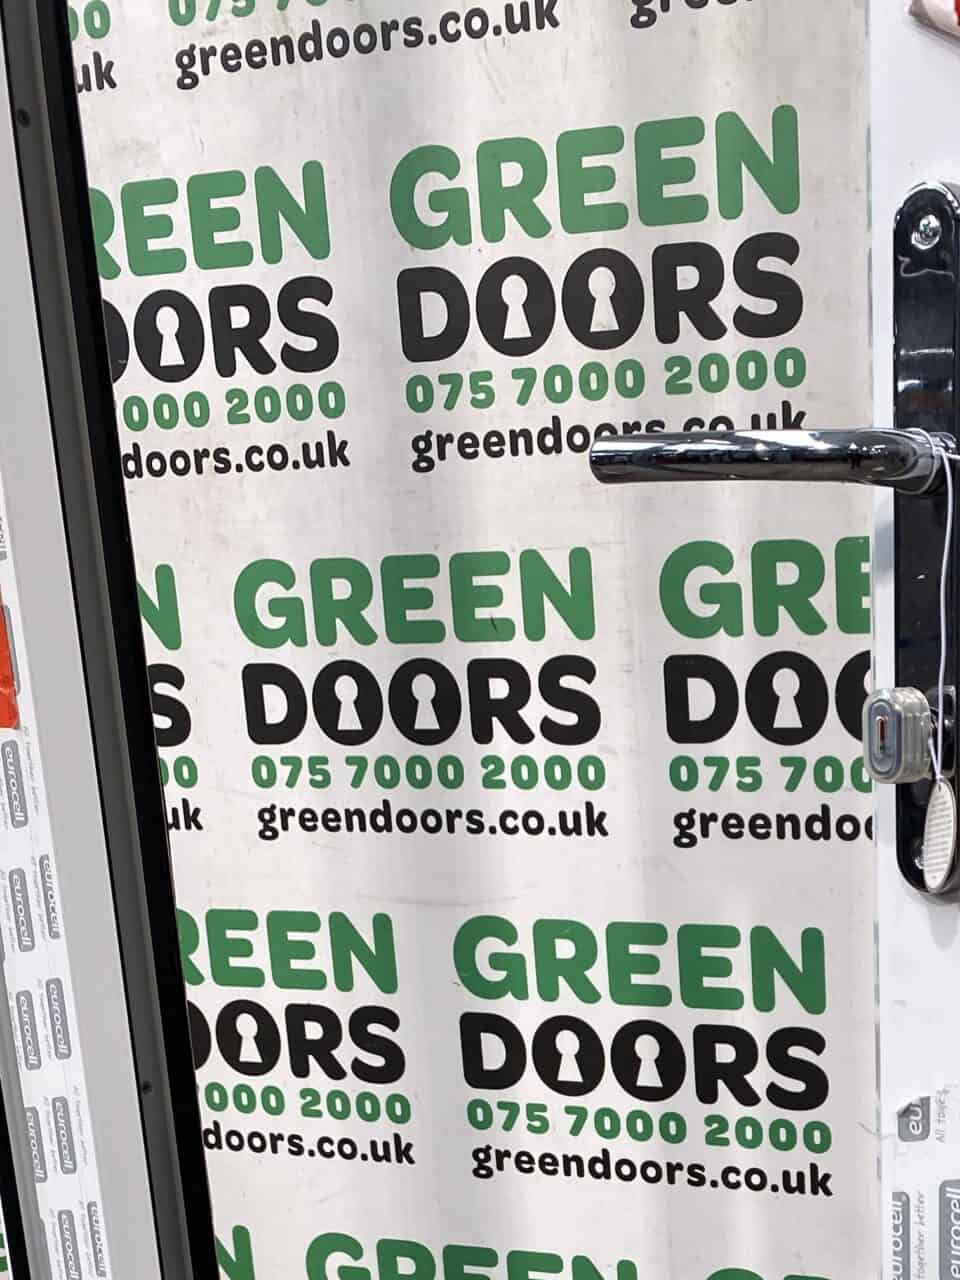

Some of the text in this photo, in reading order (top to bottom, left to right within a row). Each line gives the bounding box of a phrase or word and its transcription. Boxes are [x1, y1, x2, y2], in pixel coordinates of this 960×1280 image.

[175, 0, 561, 90] greendoors.co.uk
[390, 104, 800, 249] GREEN
[396, 231, 804, 363] DOORS
[225, 382, 346, 425] 2000
[406, 347, 807, 413] 075 7000 2000
[233, 546, 596, 649] GREEN
[241, 654, 602, 747] DOORS
[4, 745, 25, 826] eurocell
[251, 754, 606, 791] 075 7000 2000
[668, 755, 763, 793] 075
[257, 798, 609, 841] greendoors.co.uk
[12, 874, 32, 950] eurocell
[452, 915, 826, 1015] GREEN
[19, 995, 39, 1068] eurocell
[49, 982, 69, 1058] eurocell
[458, 1011, 830, 1112] DOORS
[54, 1102, 75, 1174] eurocell
[299, 1087, 411, 1125] 2000
[466, 1098, 833, 1154] 075 7000 2000
[471, 1144, 833, 1197] greendoors.co.uk
